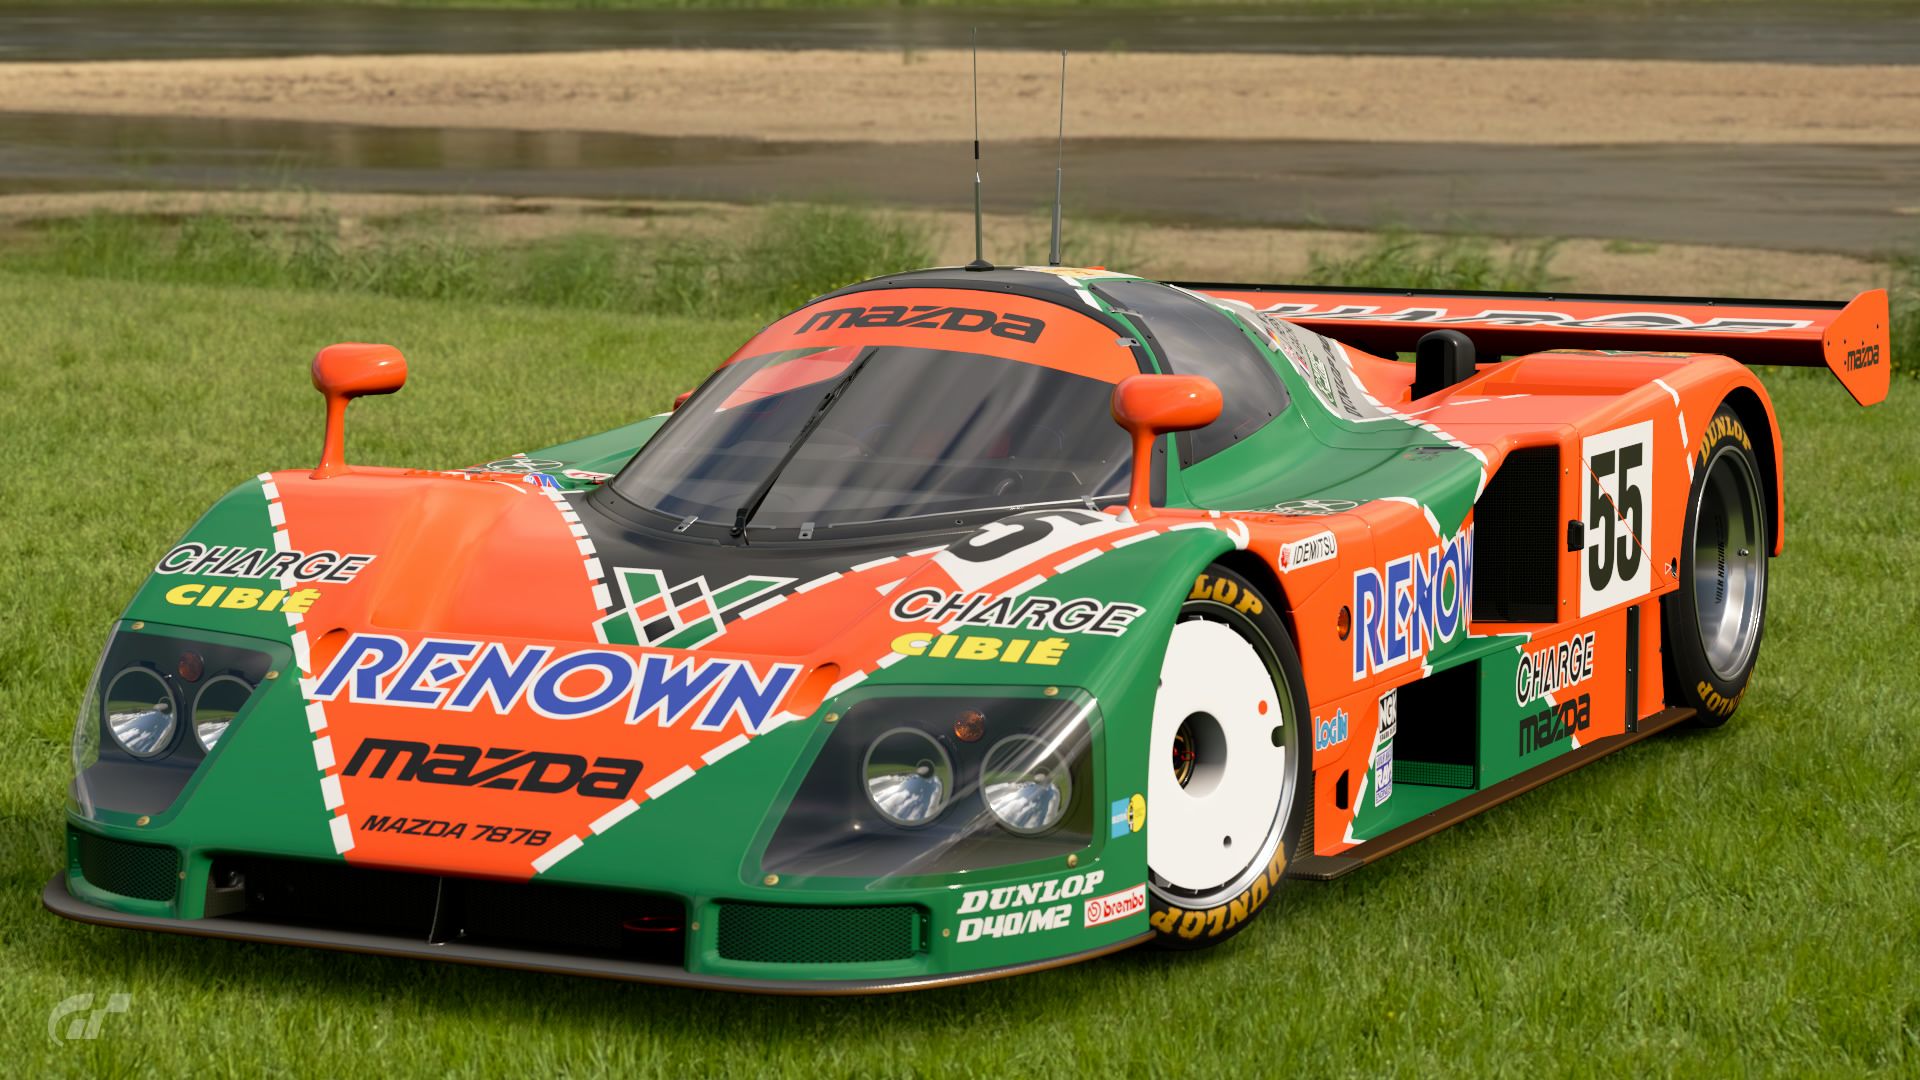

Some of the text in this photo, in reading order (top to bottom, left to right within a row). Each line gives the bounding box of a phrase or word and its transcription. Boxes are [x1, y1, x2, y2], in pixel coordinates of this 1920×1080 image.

[1222, 299, 1815, 334] HARGE
[1588, 442, 1643, 592] 55
[154, 541, 376, 585] CHARGE
[1293, 535, 1336, 566] IDEMITSU
[165, 583, 321, 614] CIBIÉ
[890, 587, 1146, 637] CHARGE
[1189, 574, 1264, 615] LOP
[1353, 524, 1475, 682] RENOW
[890, 632, 1070, 667] CIBIÉ
[1516, 631, 1595, 707] CHARGE
[313, 632, 804, 735] RENOWN
[1379, 693, 1397, 731] NGK
[360, 815, 551, 847] MAZDA 787B
[956, 869, 1104, 914] DUNLOP
[1103, 892, 1144, 917] brembo
[1149, 841, 1287, 939] DUNLOP
[956, 903, 1072, 943] D40/M2
